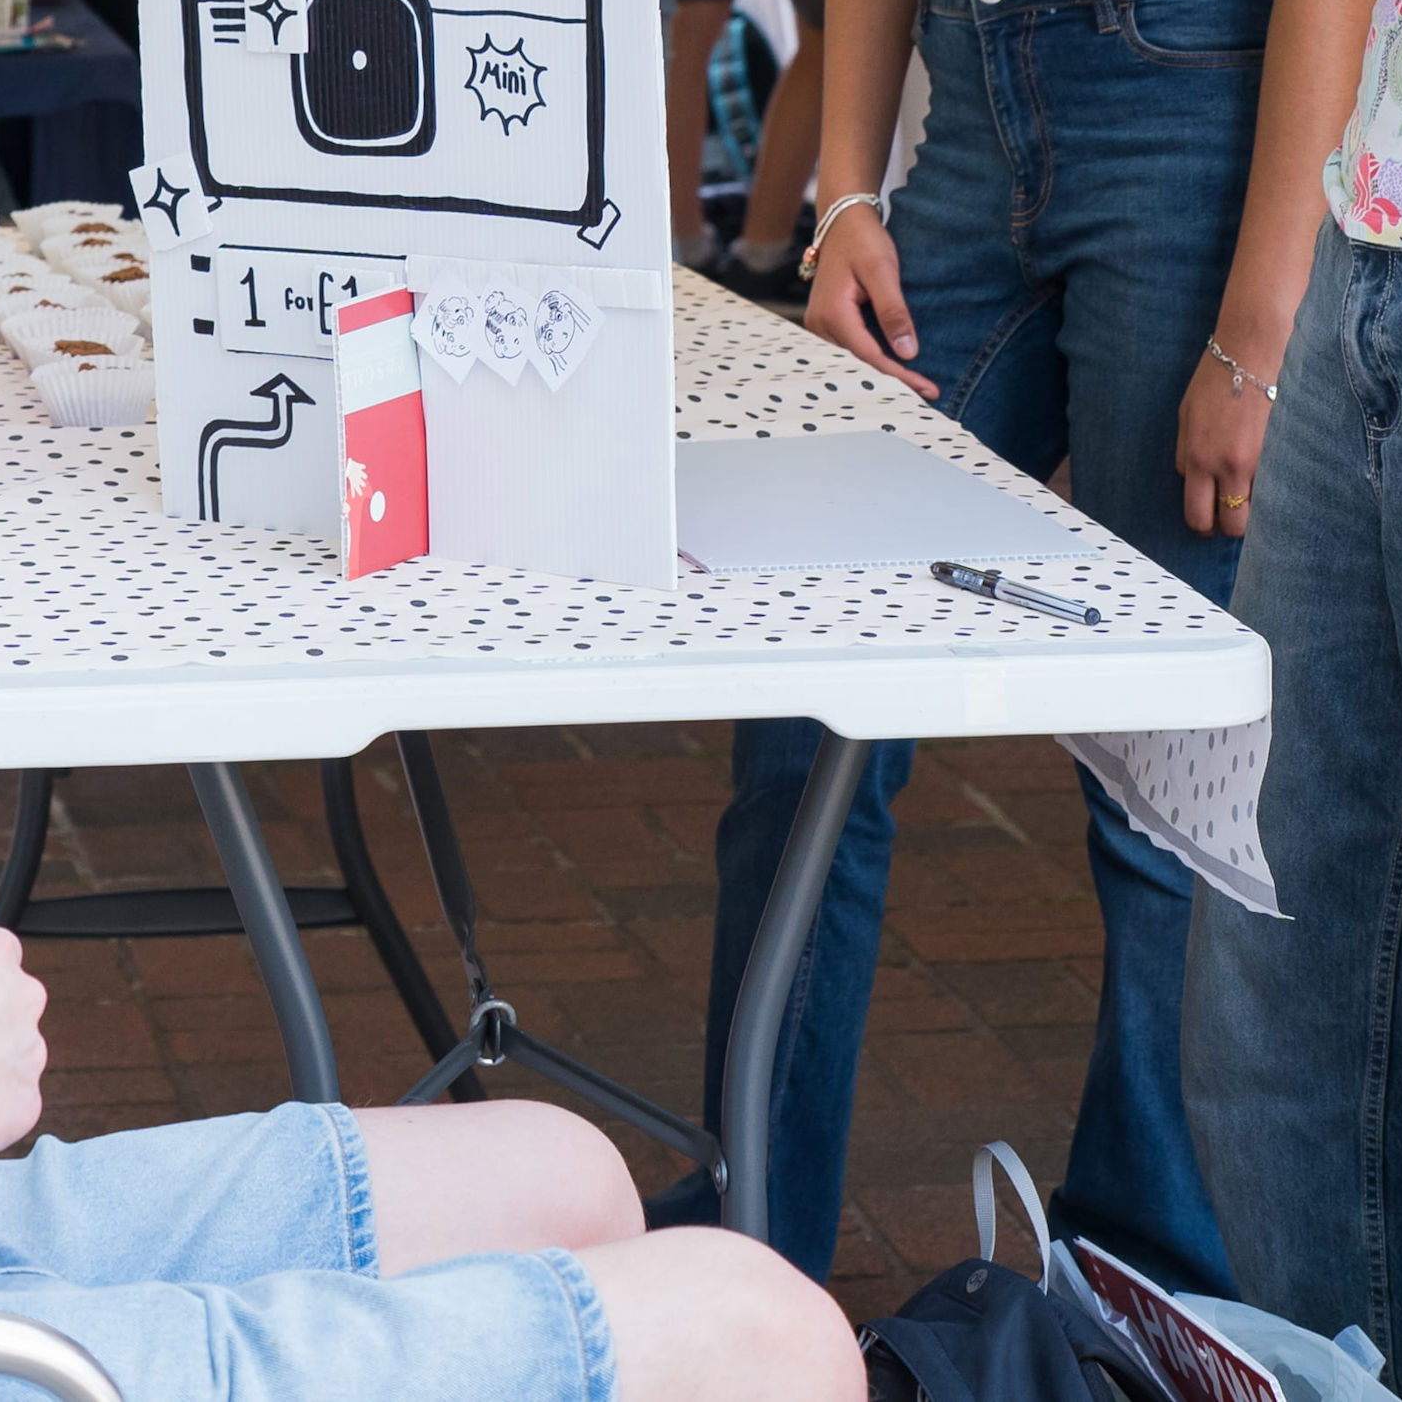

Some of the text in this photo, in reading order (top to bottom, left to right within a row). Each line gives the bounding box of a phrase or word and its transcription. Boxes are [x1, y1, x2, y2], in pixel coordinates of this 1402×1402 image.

[480, 60, 527, 96] Mini
[239, 266, 267, 328] 1
[284, 287, 314, 312] for
[1129, 1286, 1275, 1402] HAYW
